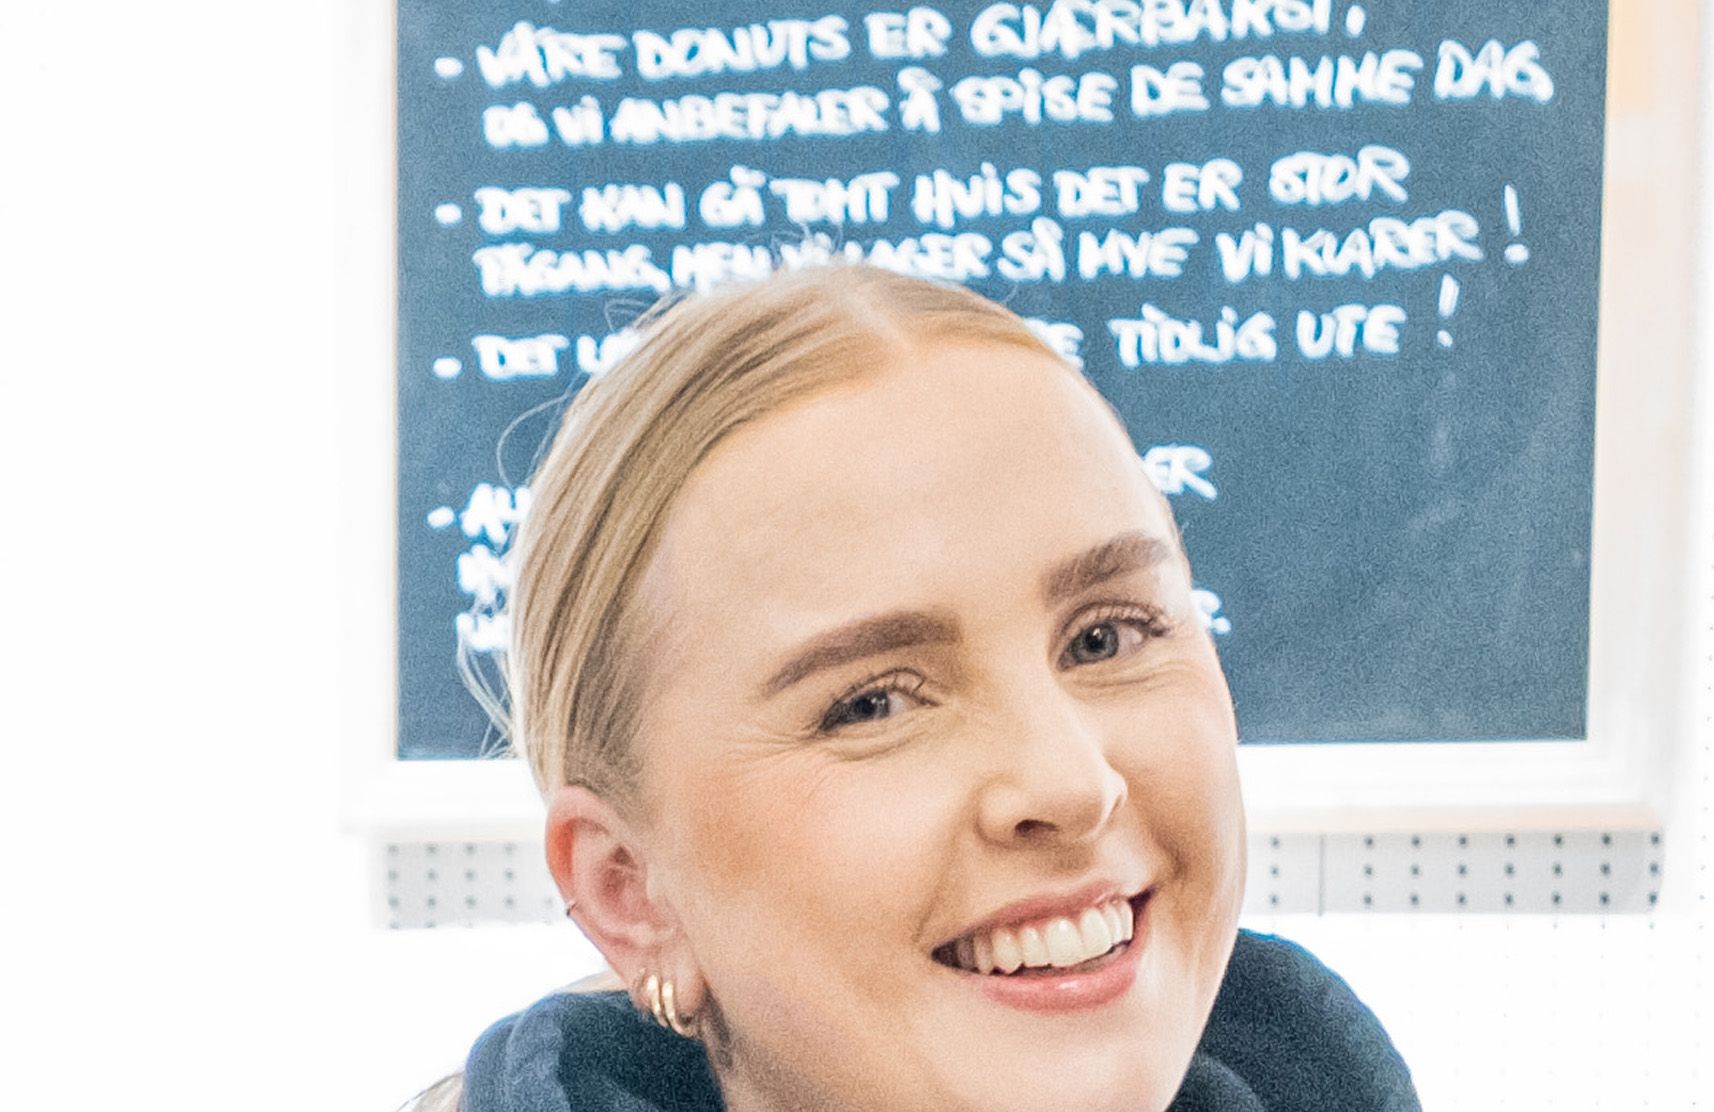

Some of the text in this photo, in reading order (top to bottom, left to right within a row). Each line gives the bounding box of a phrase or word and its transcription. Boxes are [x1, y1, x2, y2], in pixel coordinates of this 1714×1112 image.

[633, 14, 852, 80] DONUTS
[865, 6, 953, 58] ER
[483, 101, 550, 149] OG
[610, 85, 890, 144] ANBEFALER
[1130, 61, 1210, 117] DE
[1220, 49, 1424, 108] SAMME
[1433, 39, 1555, 102] DAG
[474, 186, 571, 236] DET
[579, 182, 686, 232] KAN
[699, 165, 768, 227] GÅ
[1052, 165, 1150, 217] DET
[1162, 158, 1243, 212] ER
[1268, 145, 1411, 205] STOR
[1077, 227, 1199, 280] MYE
[472, 333, 570, 380] DET
